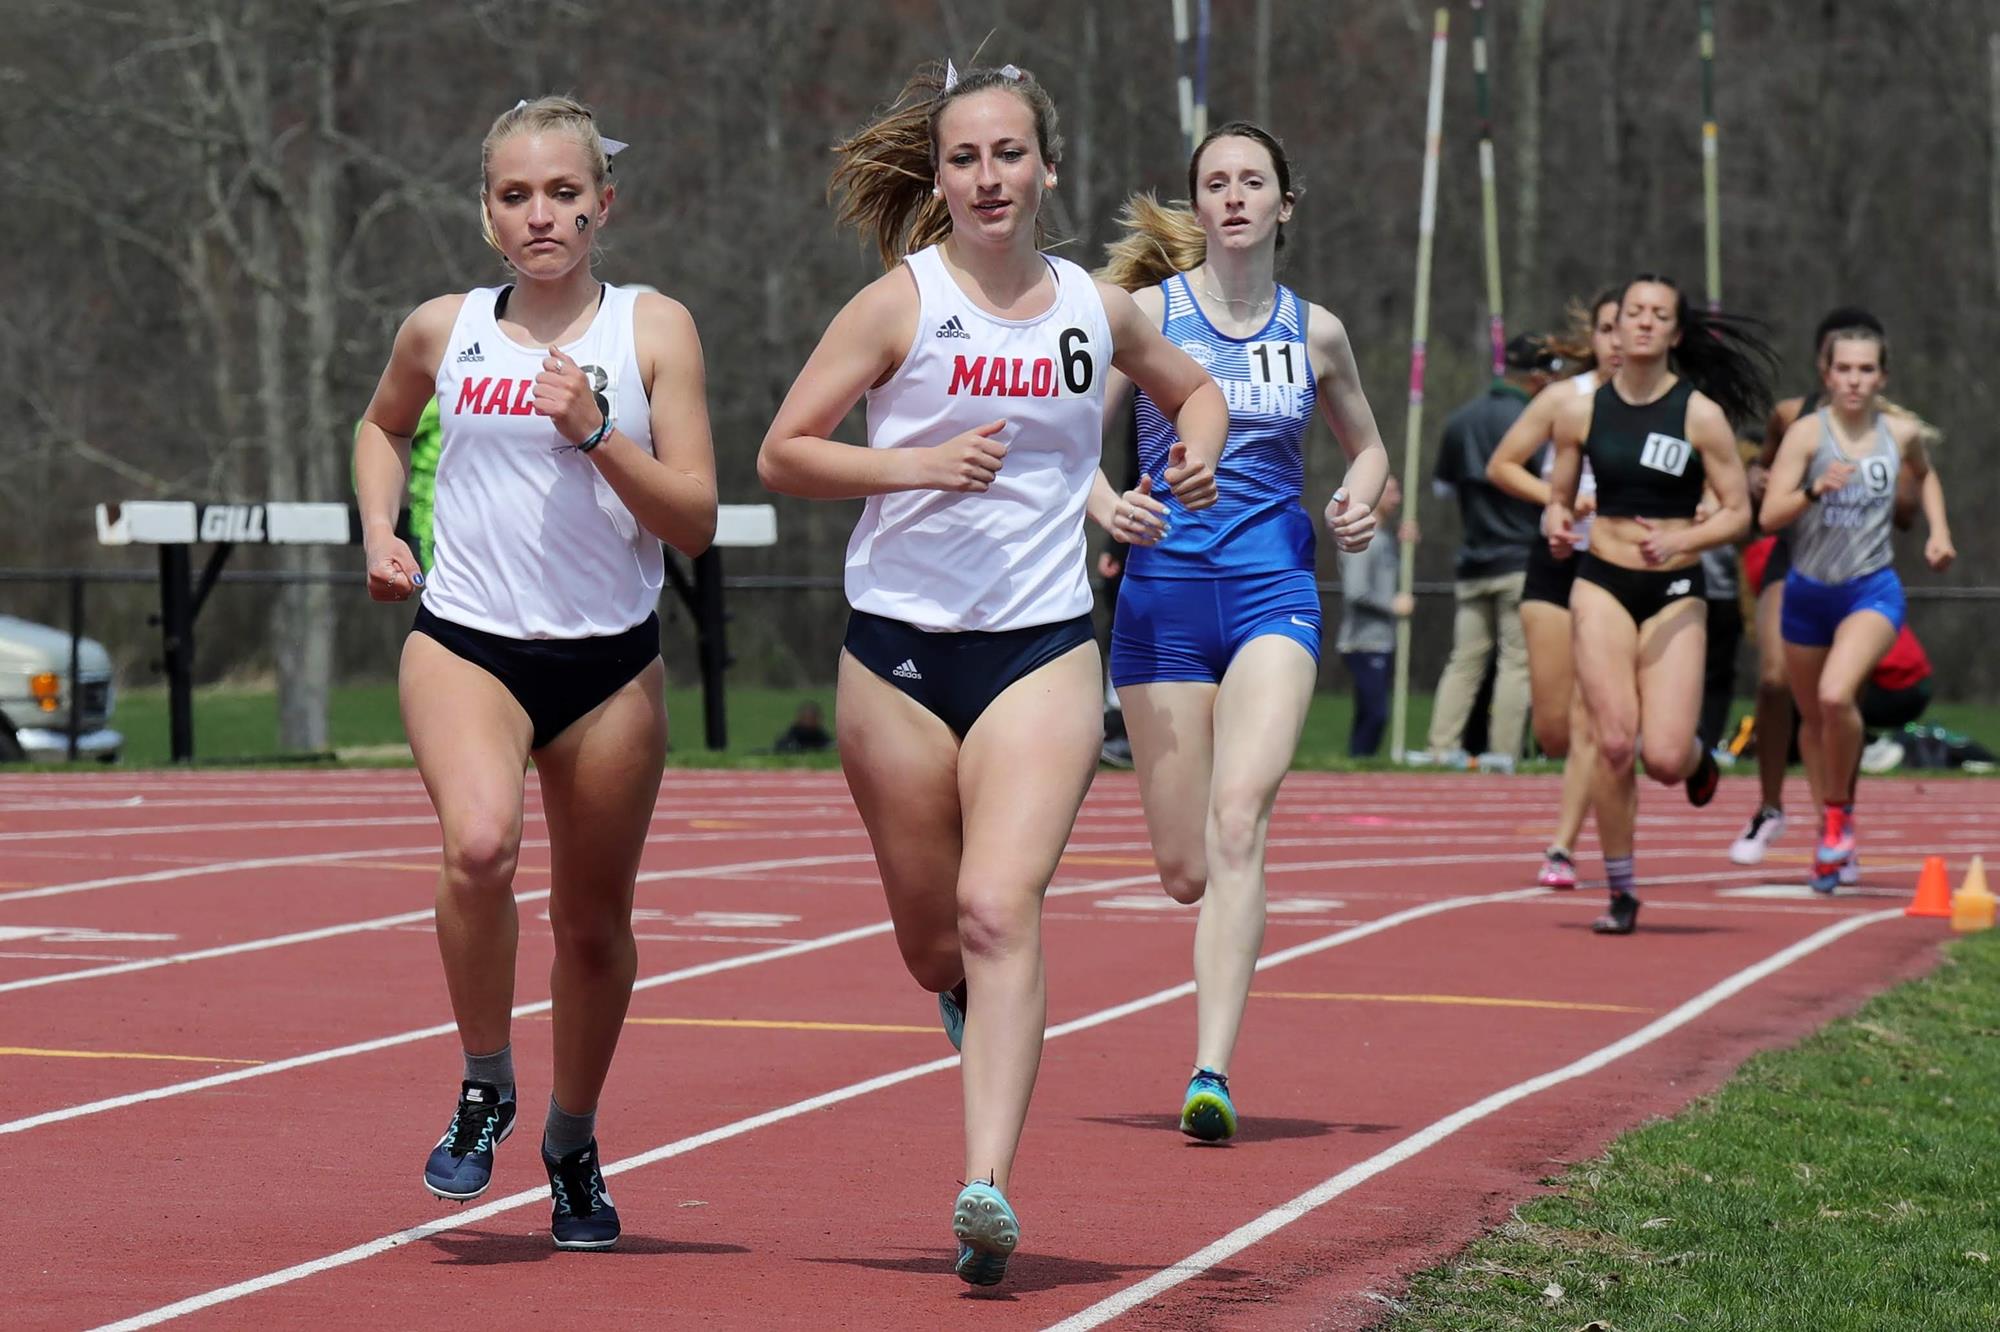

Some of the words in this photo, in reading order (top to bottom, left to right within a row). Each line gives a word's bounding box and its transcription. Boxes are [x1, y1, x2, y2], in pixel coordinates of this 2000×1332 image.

[936, 330, 971, 340] adidas
[948, 354, 1060, 397] MALO
[1059, 327, 1093, 394] 6
[1252, 343, 1294, 384] 11
[455, 377, 551, 416] MAL
[1650, 439, 1682, 471] 10
[1870, 461, 1889, 493] 9
[200, 505, 265, 542] GILL
